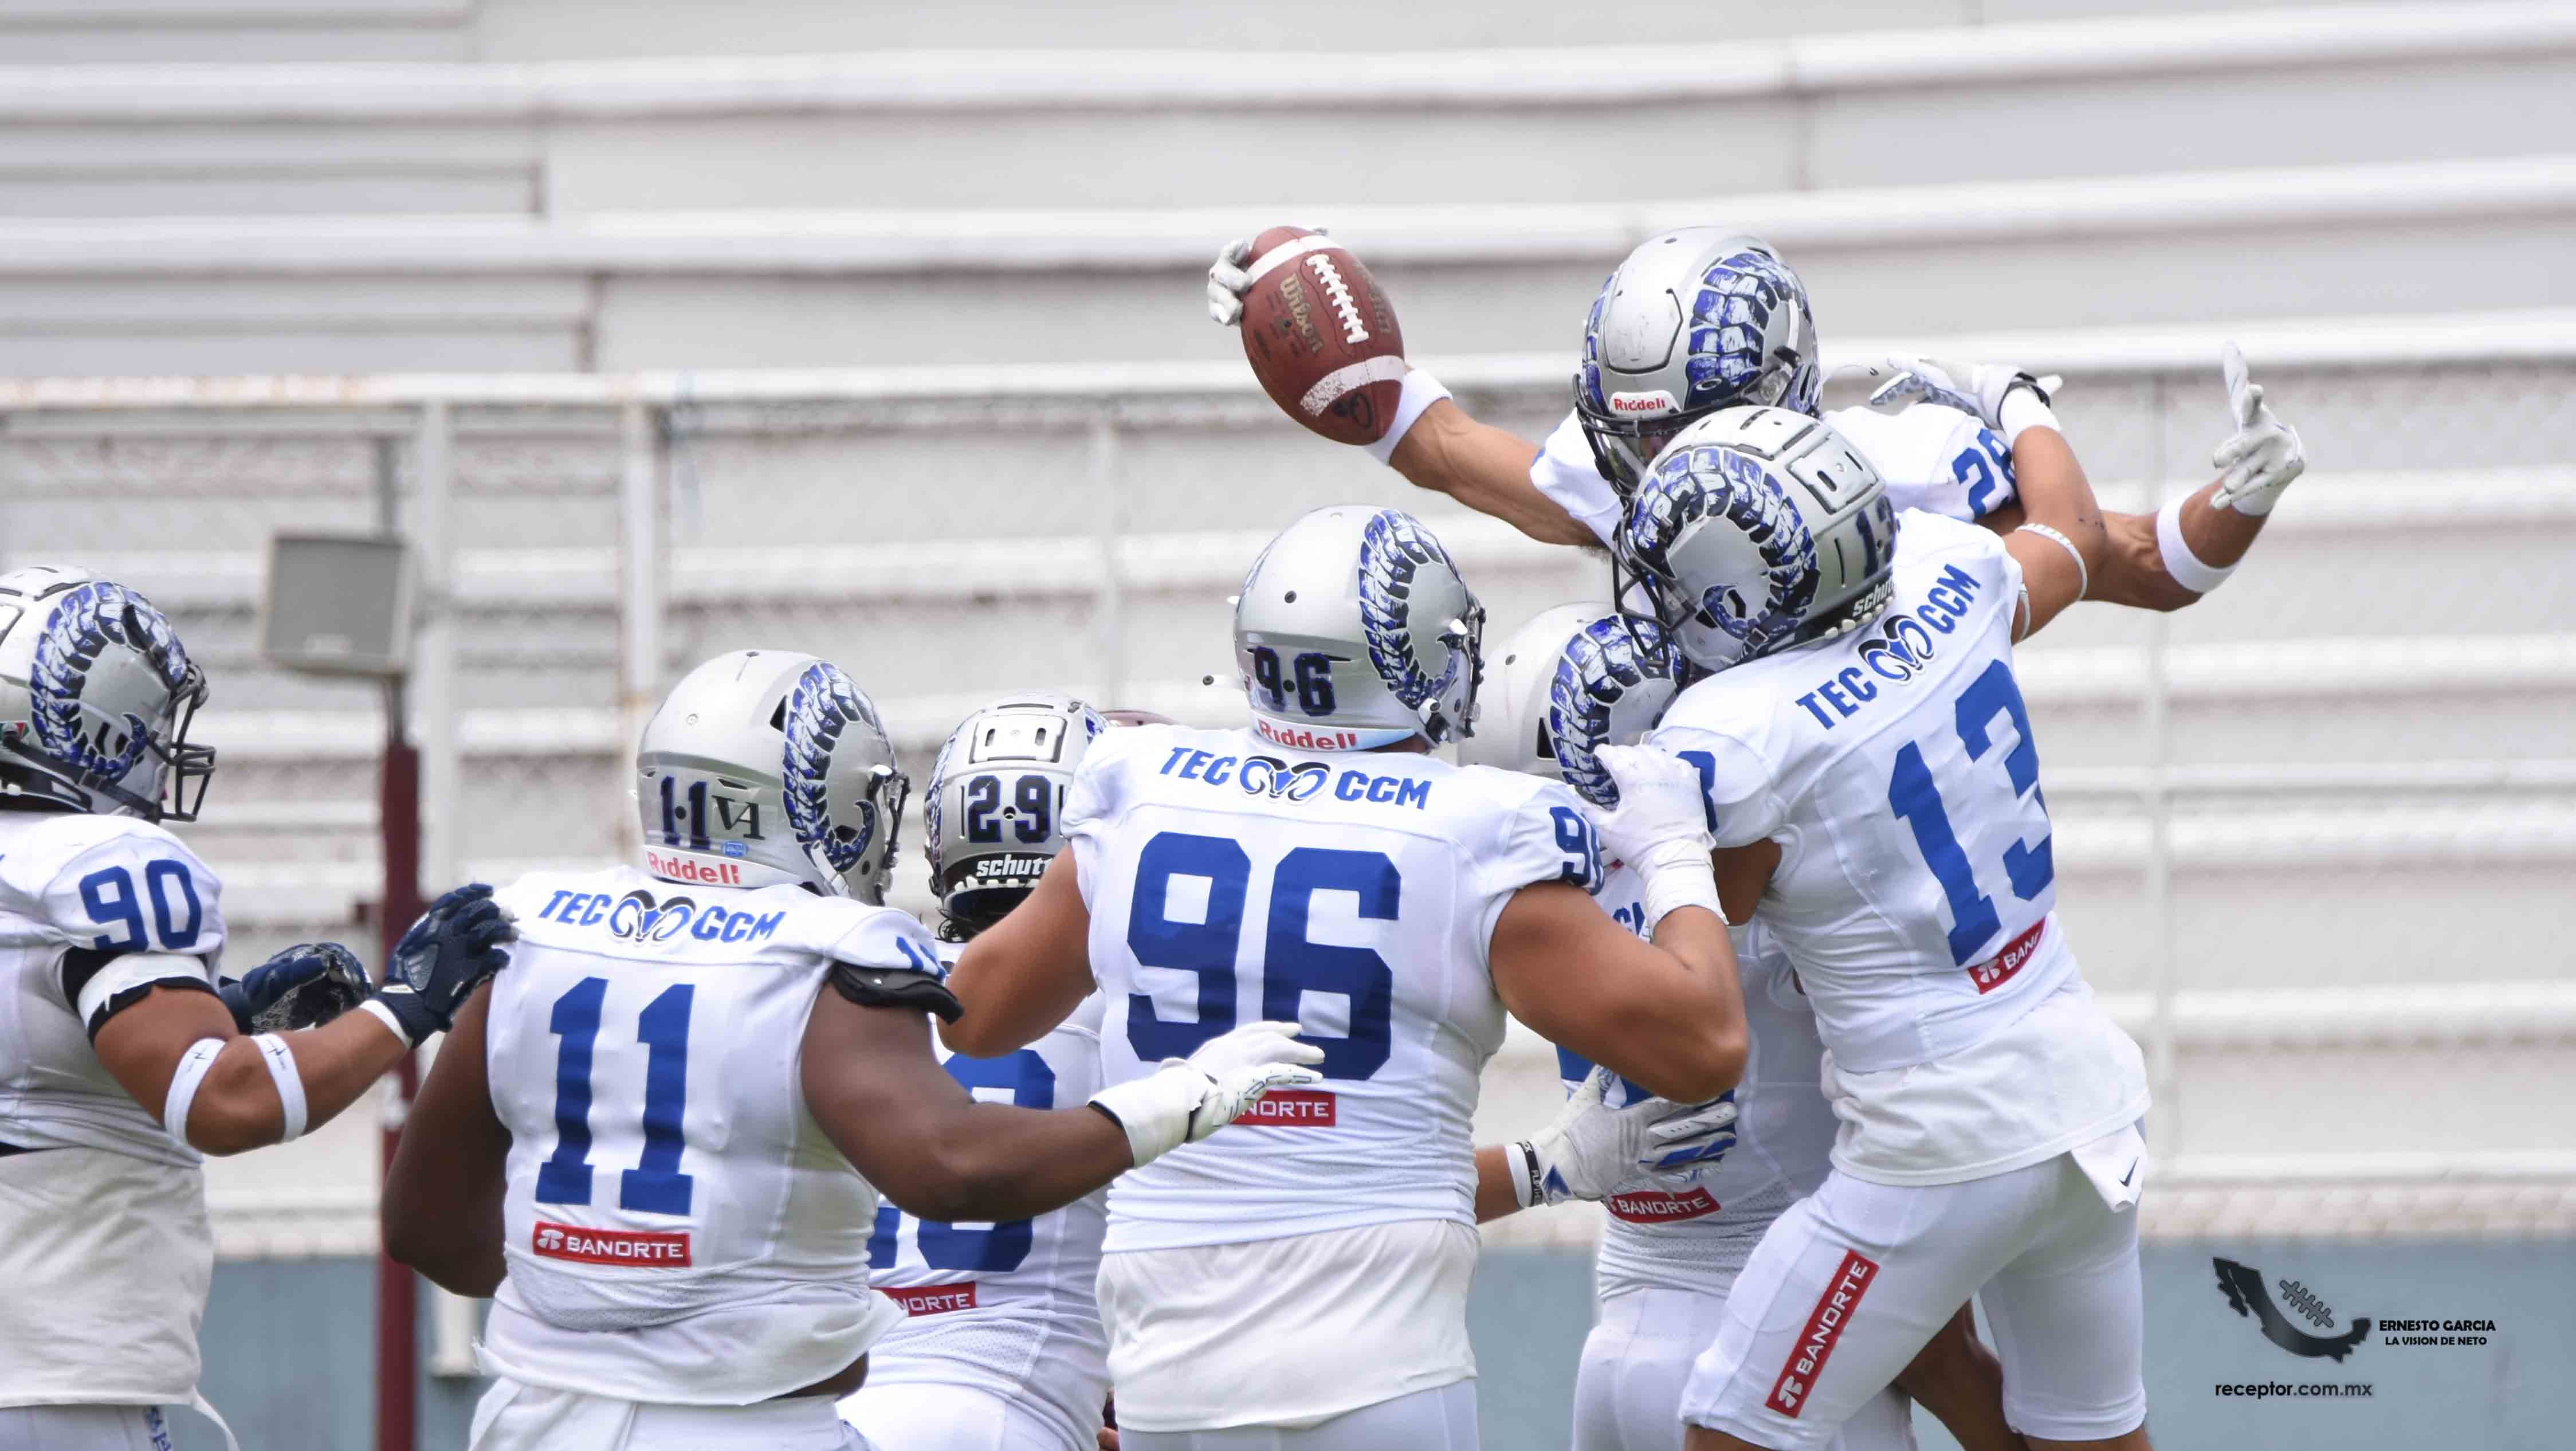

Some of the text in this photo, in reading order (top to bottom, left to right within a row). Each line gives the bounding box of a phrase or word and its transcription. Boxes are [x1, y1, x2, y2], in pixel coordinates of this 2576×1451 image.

[1254, 646, 1336, 716] 96
[1795, 563, 1980, 730] TEC CCM
[1258, 719, 1357, 750] Riddell
[661, 775, 710, 850] 11
[968, 775, 1051, 844] 29
[1159, 746, 1432, 810] TEC CCM
[1888, 658, 2055, 966] 13
[648, 852, 740, 884] Riddell
[78, 859, 202, 952] 90
[538, 890, 786, 943] TEC CCM
[1127, 831, 1401, 1080] 96
[535, 976, 695, 1215] 11
[1617, 1196, 1710, 1214] BANORTE
[567, 1236, 683, 1258] BANORTE
[1796, 1260, 1869, 1377] BANORTE
